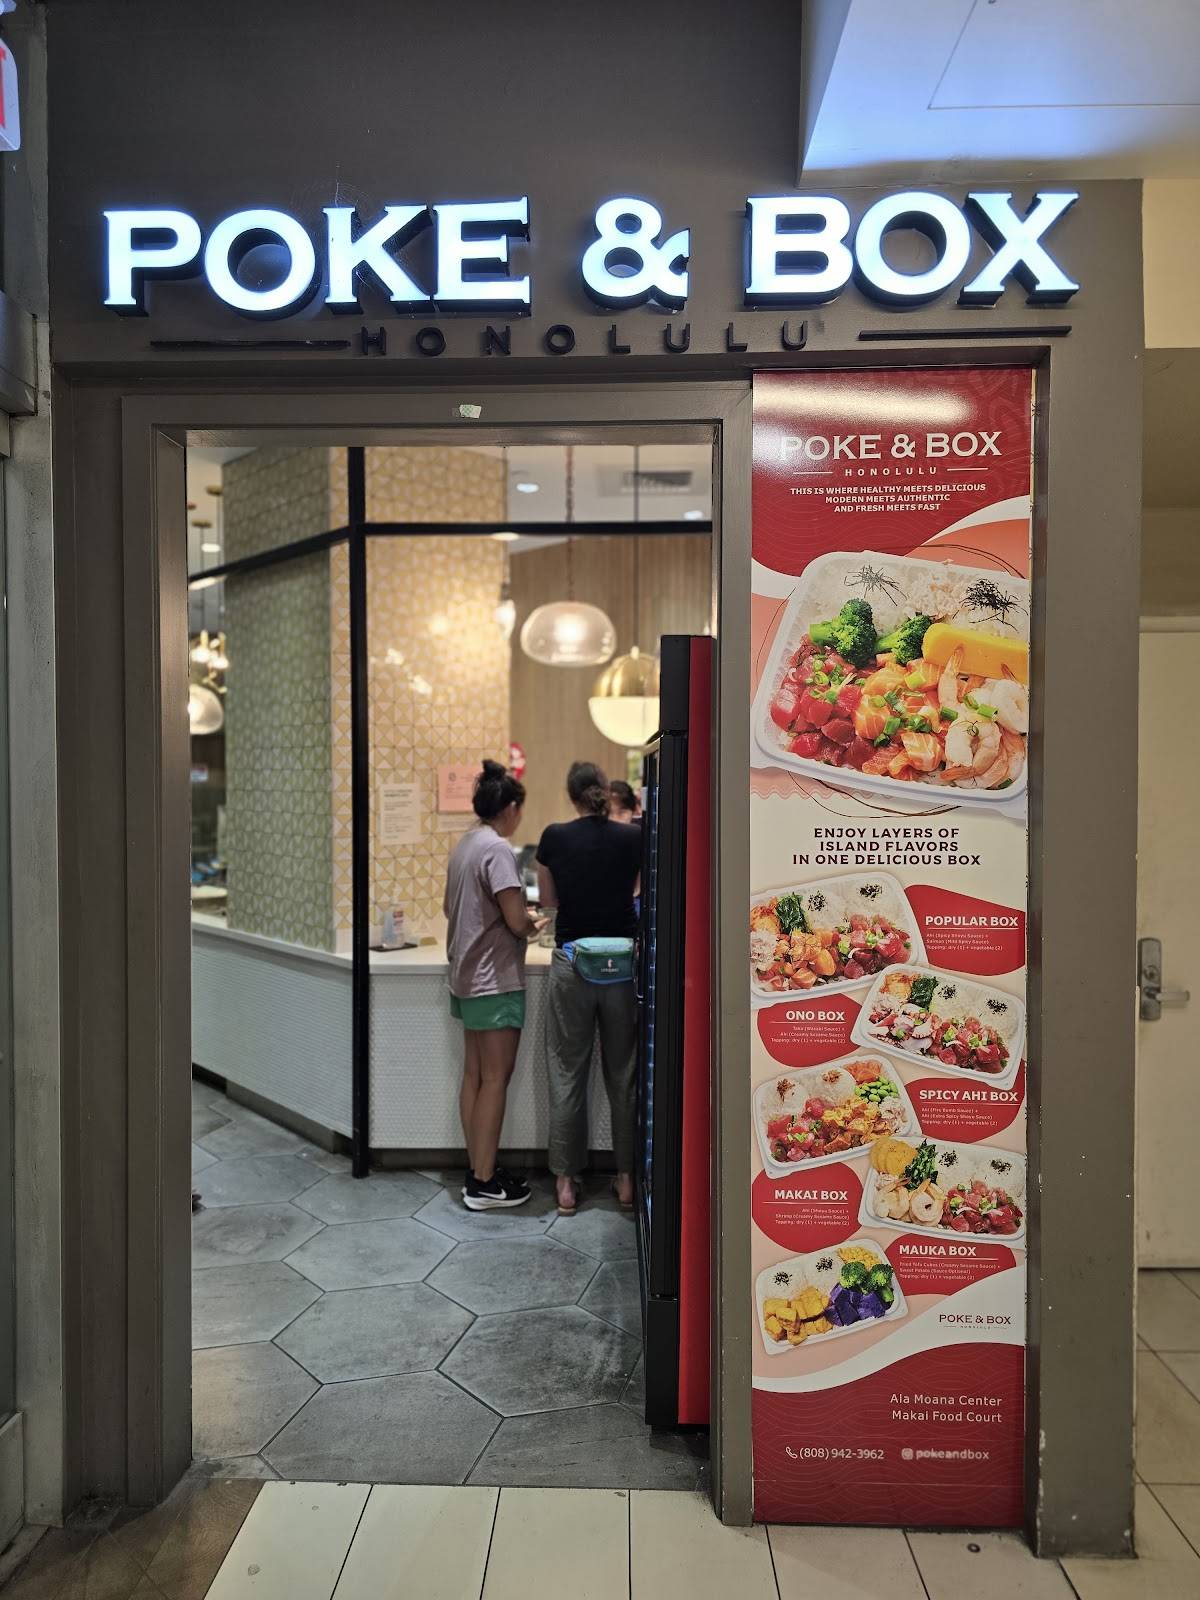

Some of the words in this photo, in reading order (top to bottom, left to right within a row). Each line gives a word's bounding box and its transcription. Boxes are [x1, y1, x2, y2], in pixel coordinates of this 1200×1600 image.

[103, 195, 531, 315] POKE
[581, 198, 690, 302] &
[744, 191, 1080, 302] BOX
[360, 320, 808, 356] HONOLULU
[781, 434, 882, 460] POKE
[890, 433, 916, 459] &
[925, 431, 1002, 458] BOX
[845, 466, 937, 477] HONOLULU
[790, 487, 812, 495] THIS
[814, 487, 824, 495] IS
[826, 486, 858, 495] WHERE
[860, 486, 901, 494] HEALTHY
[903, 484, 933, 493] MEETS
[935, 483, 986, 492] DELICIOUS
[825, 496, 864, 504] MODERN
[866, 495, 896, 503] MEETS
[897, 494, 950, 502] AUTHENTIC
[834, 505, 854, 513] AND
[855, 504, 884, 512] FRESH
[814, 828, 866, 838] ENJOY
[872, 828, 933, 838] LAYERS
[938, 828, 960, 838] OF
[820, 841, 880, 852] ISLAND
[885, 841, 959, 852] FLAVORS
[793, 854, 810, 865] IN
[815, 854, 849, 865] ONE
[855, 854, 942, 865] DELICIOUS
[948, 854, 981, 865] BOX
[925, 916, 988, 926] POPULAR
[990, 916, 1018, 926] BOX
[786, 1010, 815, 1020] ONO
[818, 1011, 845, 1021] BOX
[919, 1090, 960, 1100] SPICY
[962, 1091, 988, 1101] AHI
[990, 1092, 1018, 1102] BOX
[774, 1190, 818, 1200] MAKAI
[820, 1190, 848, 1200] BOX
[899, 1245, 946, 1255] MAUKA
[949, 1246, 977, 1256] BOX
[939, 1314, 973, 1324] POKE
[975, 1315, 984, 1324] &
[986, 1316, 1011, 1325] BOX
[914, 1394, 955, 1405] Moana
[959, 1395, 1002, 1406] Center
[892, 1410, 928, 1420] Makai
[932, 1411, 962, 1421] Food
[966, 1412, 1002, 1422] Court
[799, 1448, 829, 1460] (808)
[831, 1448, 884, 1459] 942-3962
[916, 1448, 990, 1460] pokeandbox
